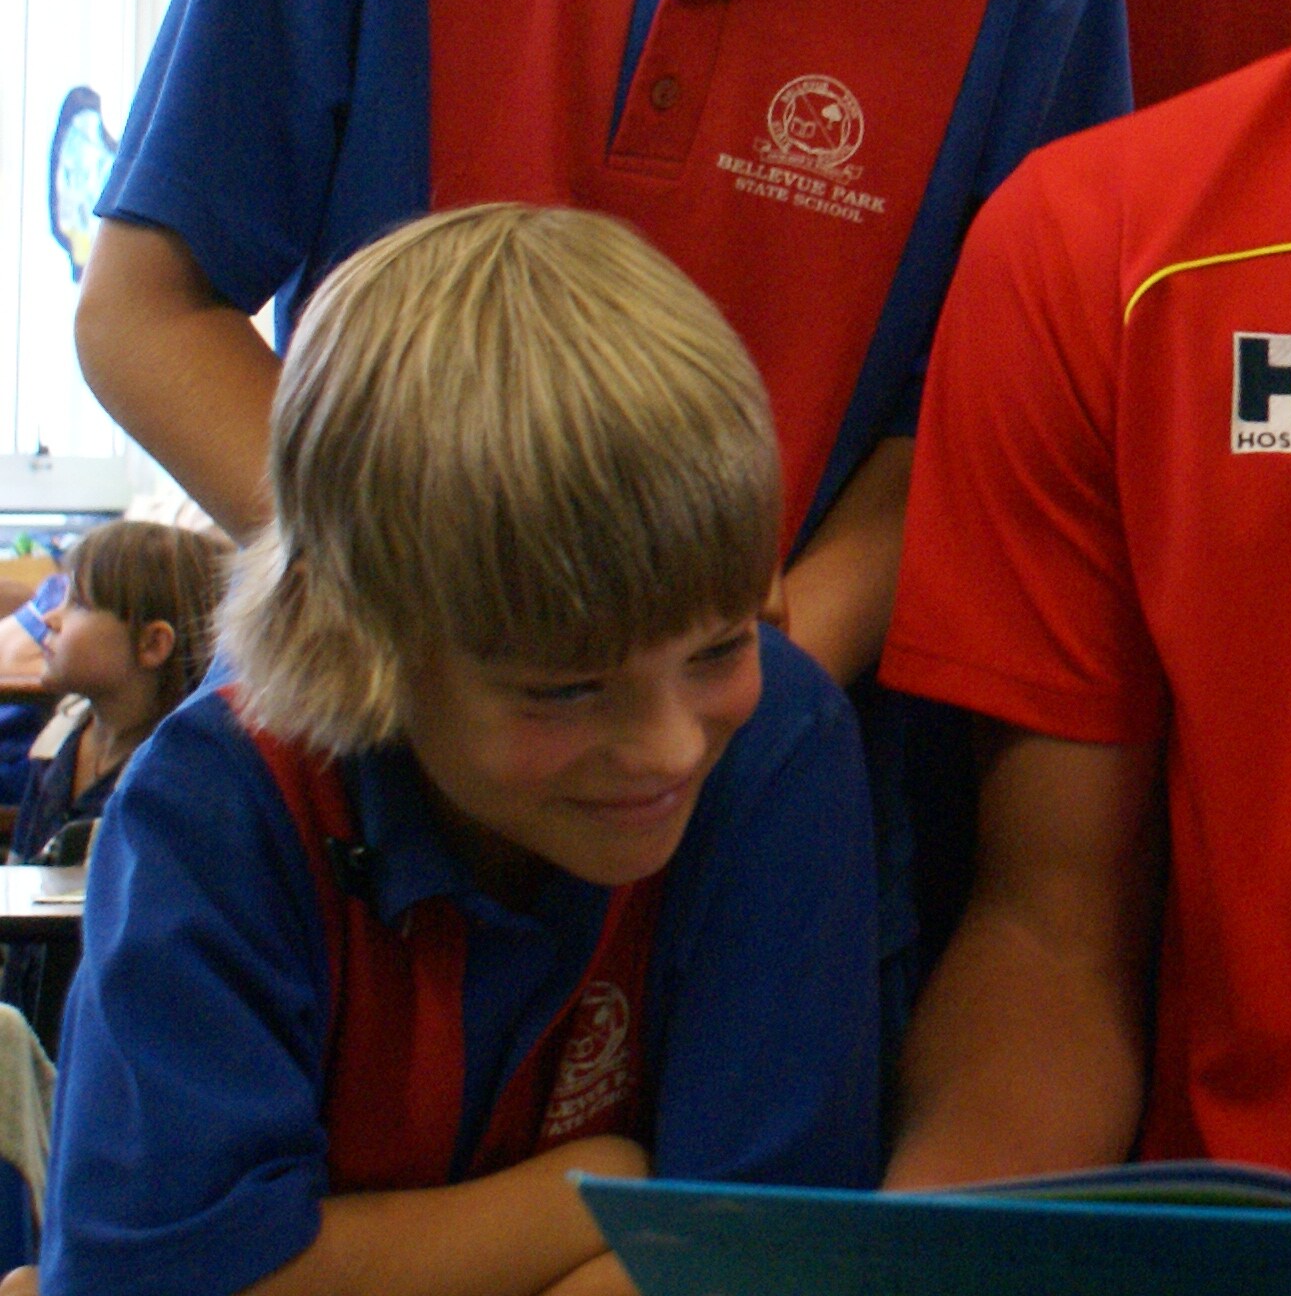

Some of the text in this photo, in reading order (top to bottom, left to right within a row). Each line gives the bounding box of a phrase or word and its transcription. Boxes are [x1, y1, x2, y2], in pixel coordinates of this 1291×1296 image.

[717, 154, 885, 213] BELLEVUE PARK
[735, 178, 863, 223] STATE SCHOOL
